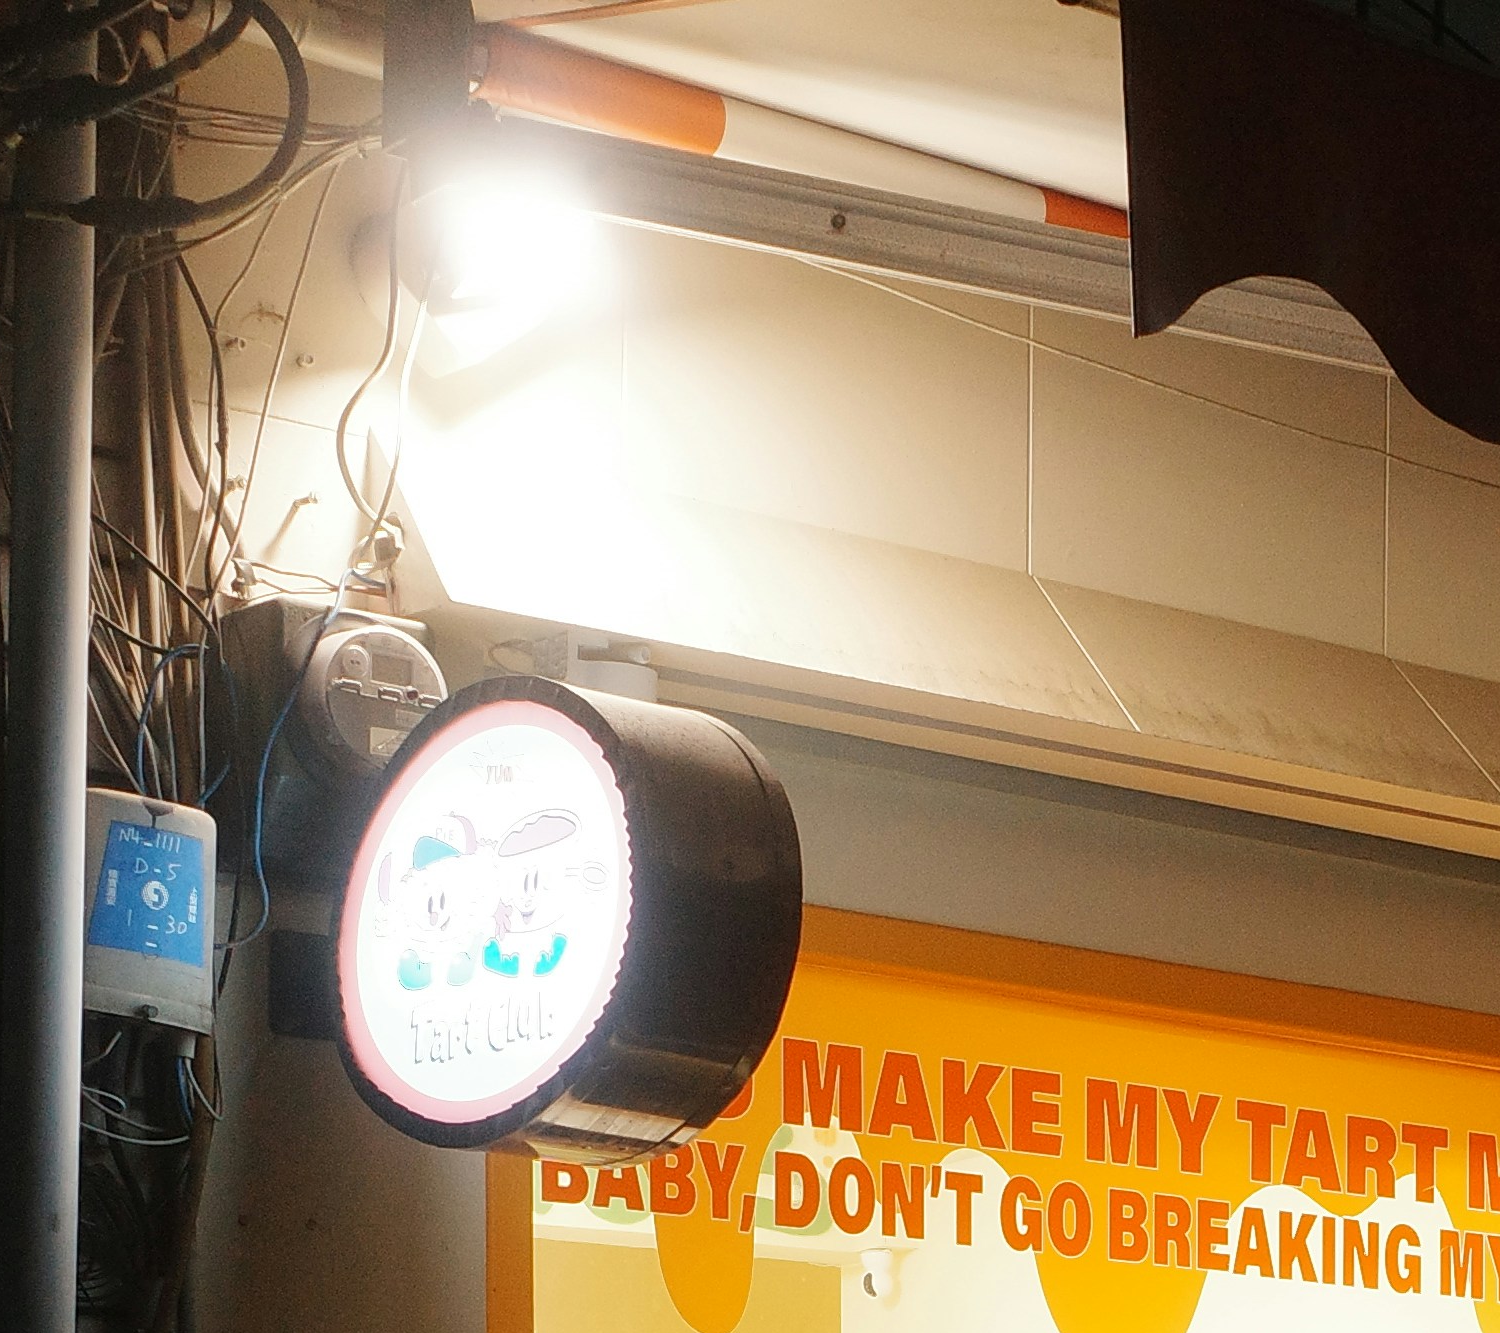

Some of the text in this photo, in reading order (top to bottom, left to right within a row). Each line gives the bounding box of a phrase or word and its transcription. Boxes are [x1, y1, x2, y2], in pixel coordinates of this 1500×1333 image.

[781, 1037, 1063, 1157] MAKE
[1085, 1078, 1220, 1172] MY
[1235, 1101, 1450, 1203] TART
[775, 1153, 983, 1247] DON'T
[1000, 1187, 1092, 1258] GO
[1108, 1188, 1421, 1295] BREAKING
